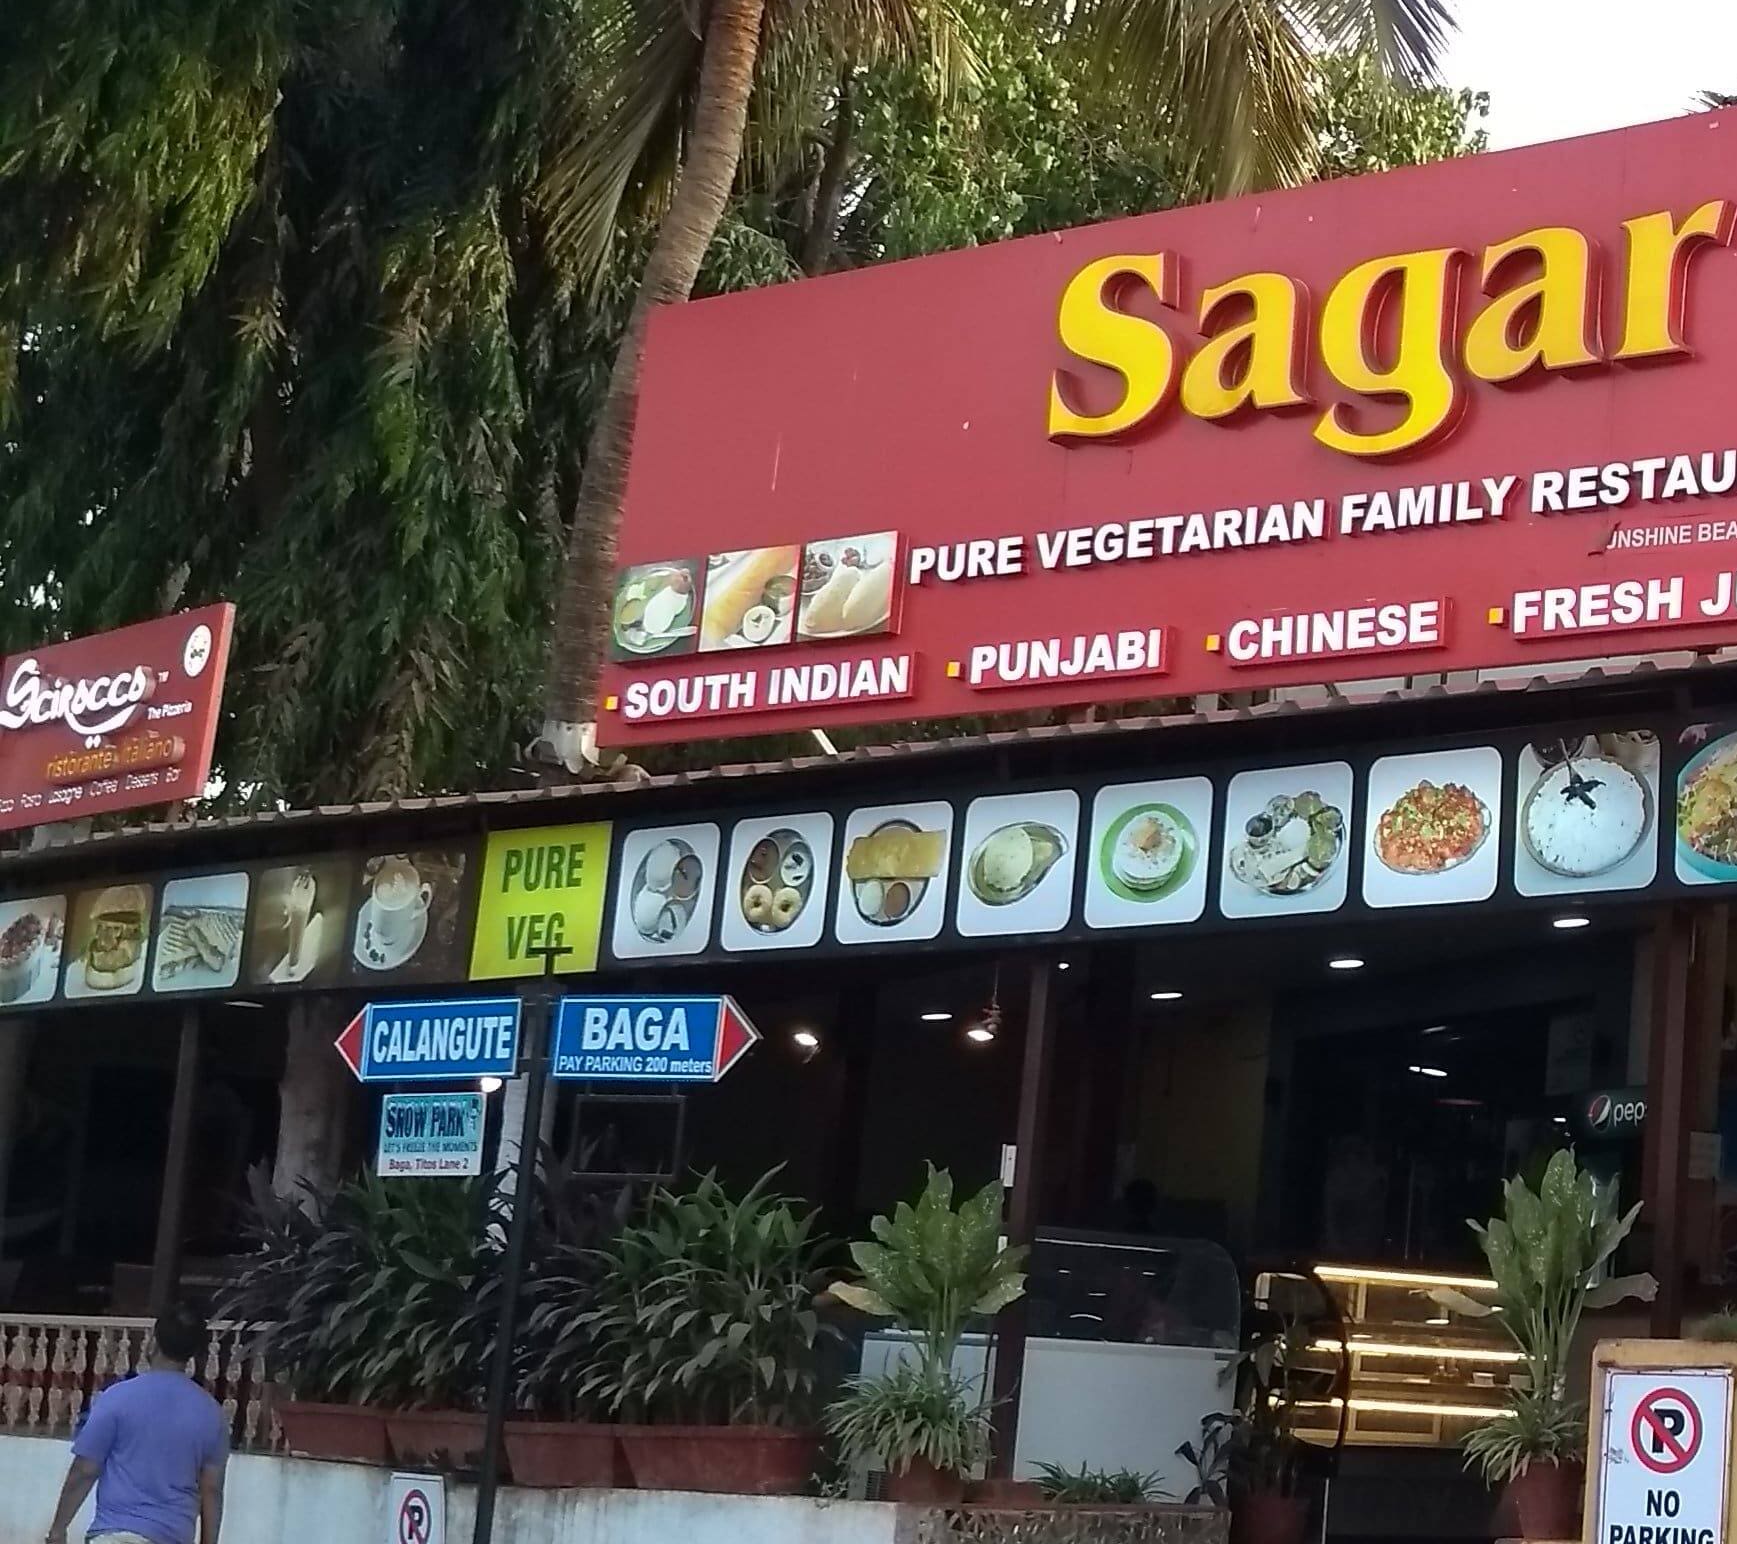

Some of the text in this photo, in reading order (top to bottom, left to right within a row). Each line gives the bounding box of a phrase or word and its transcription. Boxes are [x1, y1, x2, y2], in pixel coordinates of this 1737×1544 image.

[1047, 200, 1735, 457] Sagar
[909, 536, 1023, 585] PURE
[1036, 498, 1326, 570] VEGETARIAN
[1340, 476, 1517, 535] FAMILY
[1512, 576, 1684, 634] FRESH
[1227, 599, 1440, 662] CHINESE
[969, 628, 1162, 685] PUNJABI
[624, 655, 910, 720] SOUTH INDIAN
[47, 749, 113, 778] ristorante
[501, 843, 586, 894] PURE
[507, 912, 565, 960] VEG
[372, 1015, 514, 1063] CALANGUTE
[581, 1007, 690, 1051] BAGA
[558, 1055, 713, 1073] PAY PARKING 200 meters
[430, 1102, 465, 1137] PARK
[1613, 1101, 1648, 1127] pep
[462, 1157, 469, 1170] 2
[1646, 1489, 1681, 1518] NO
